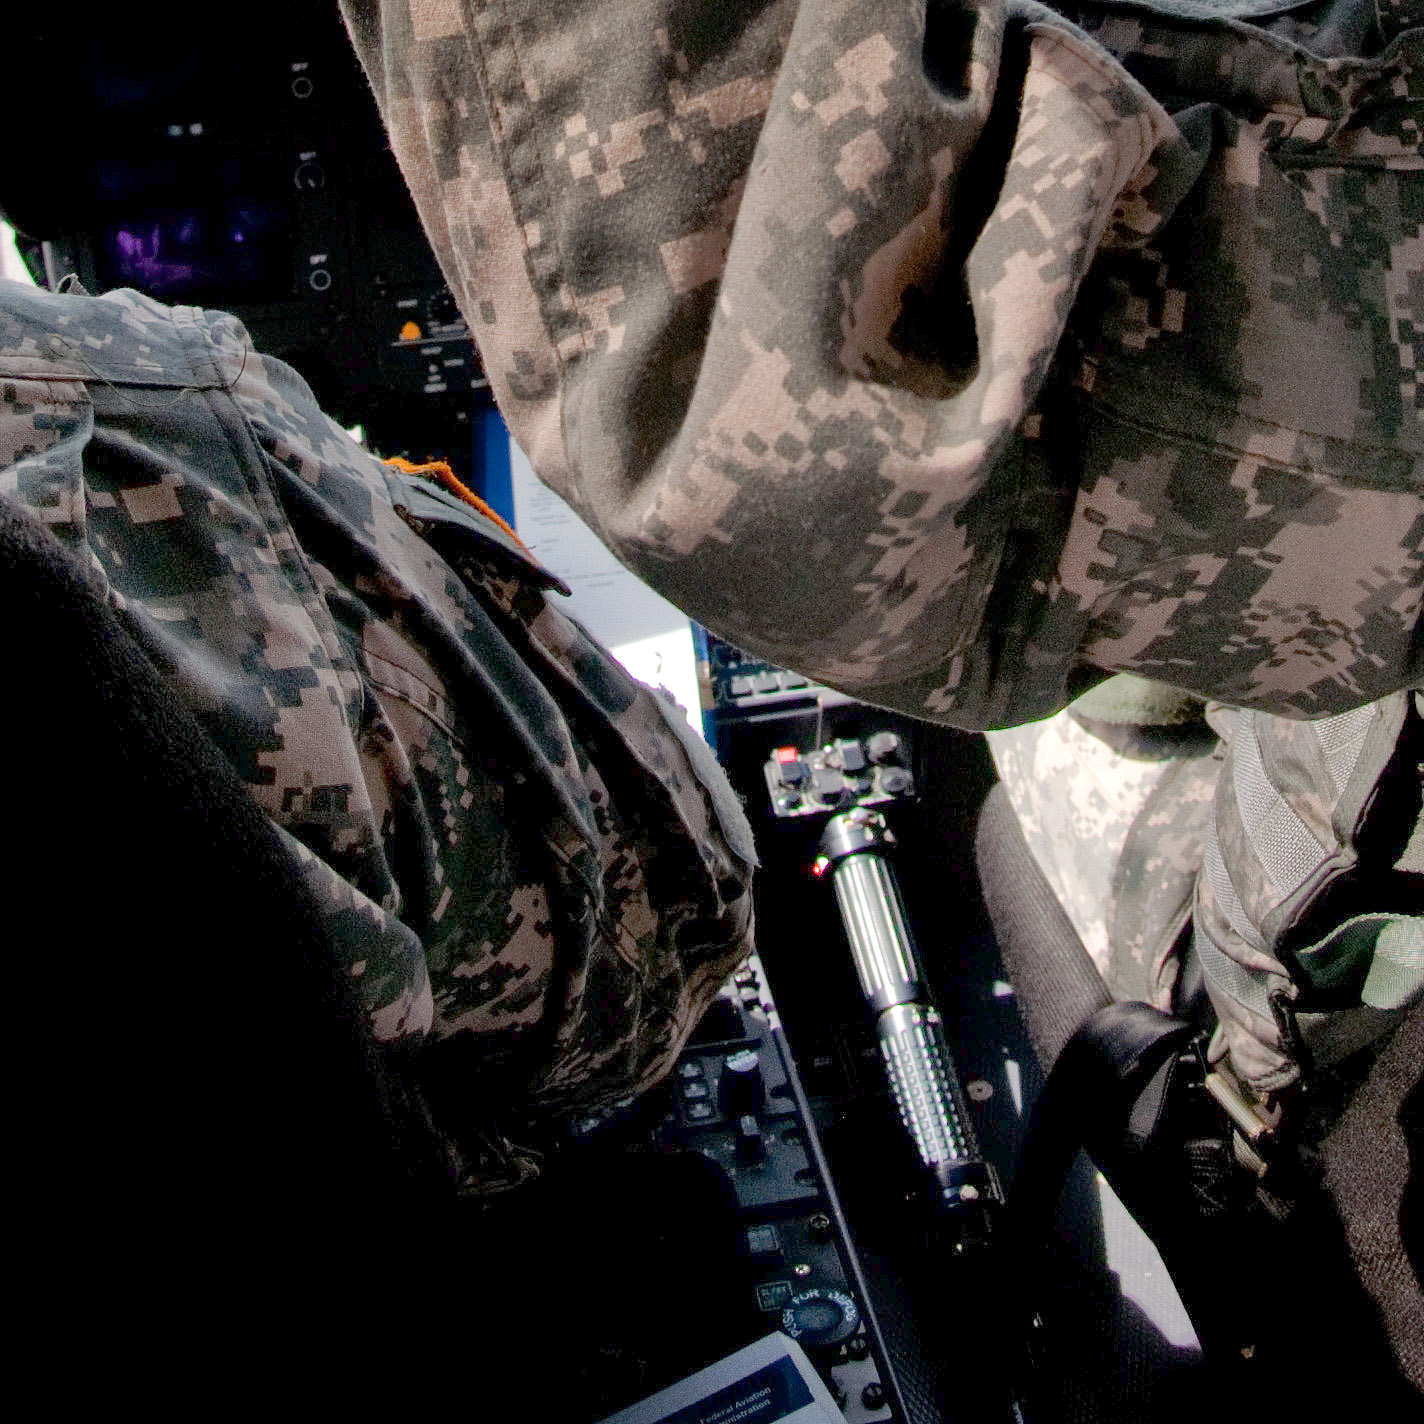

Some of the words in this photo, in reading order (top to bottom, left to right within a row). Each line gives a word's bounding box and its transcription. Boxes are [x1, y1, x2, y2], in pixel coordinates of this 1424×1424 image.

[791, 1288, 820, 1305] FOR
[827, 1290, 856, 1322] DEFOG
[735, 1386, 772, 1409] Aviation
